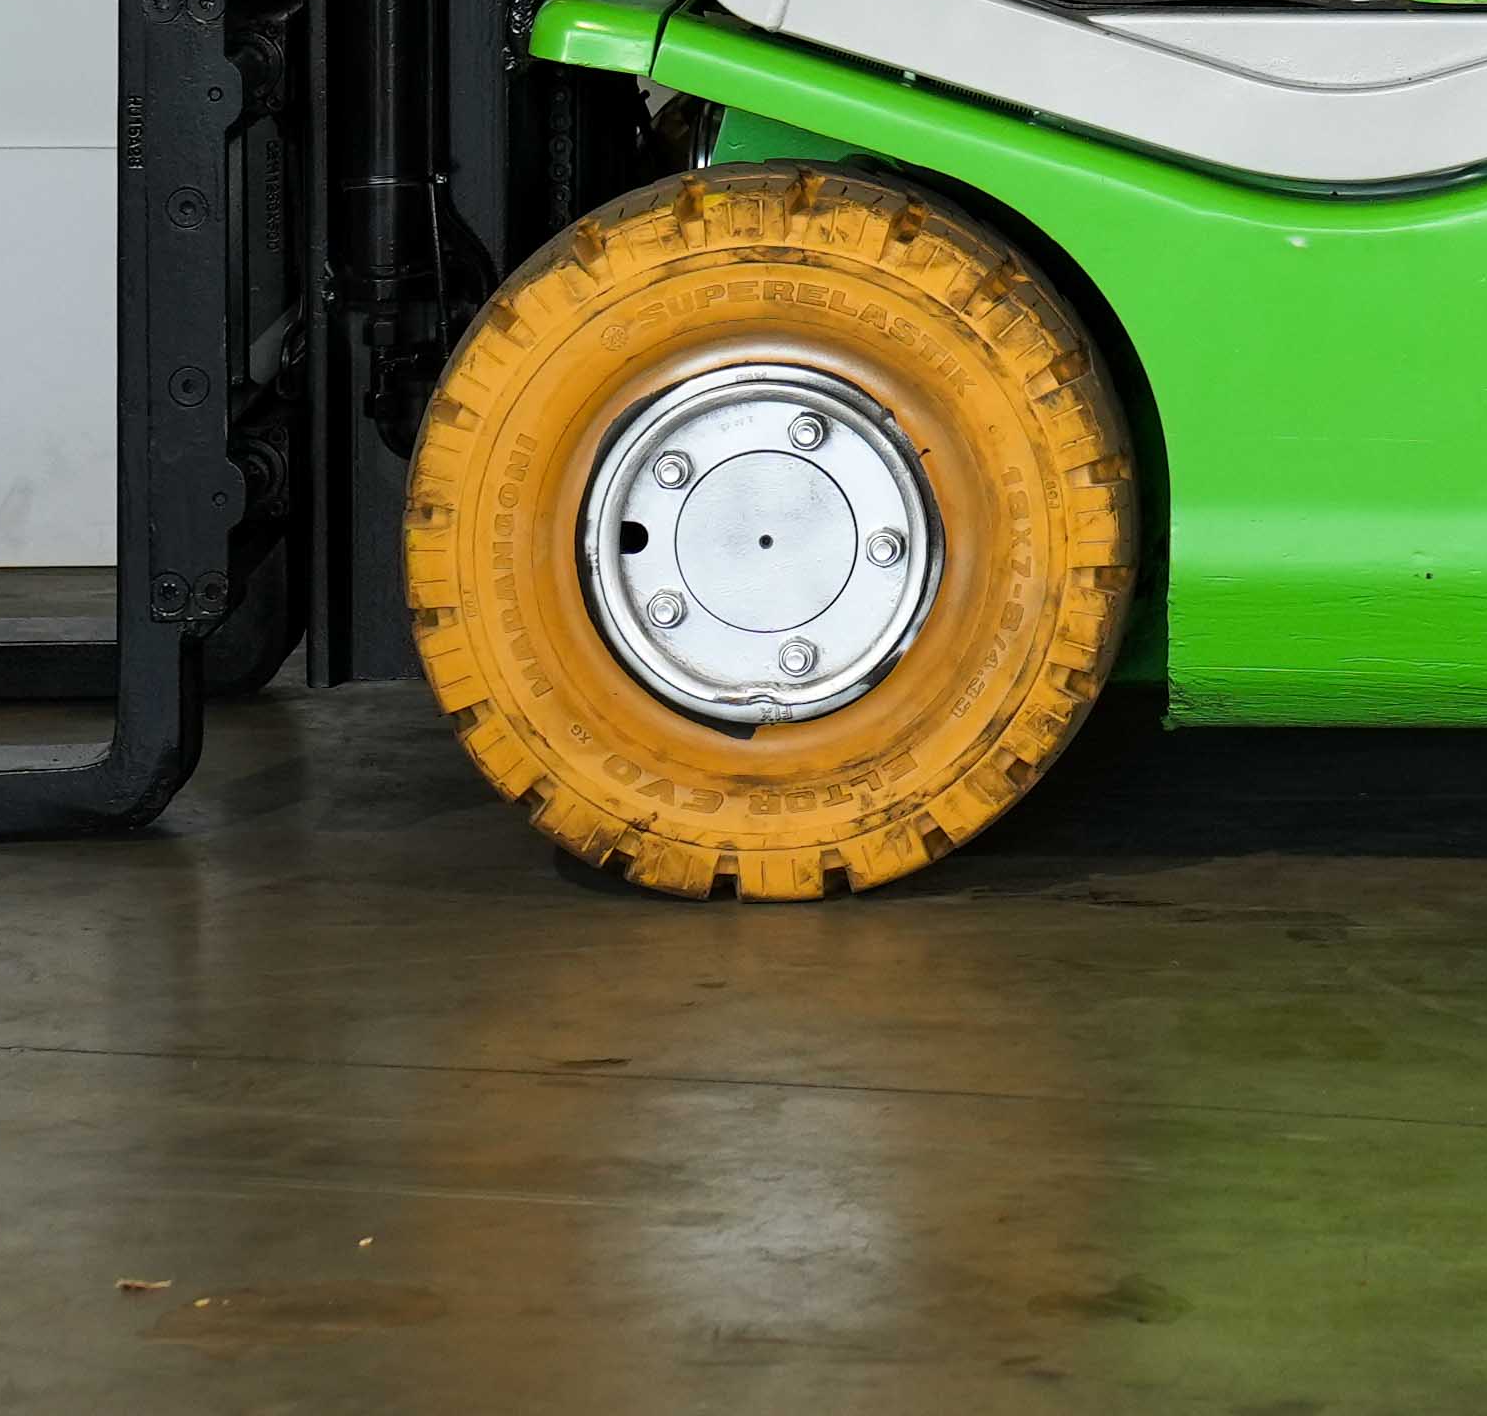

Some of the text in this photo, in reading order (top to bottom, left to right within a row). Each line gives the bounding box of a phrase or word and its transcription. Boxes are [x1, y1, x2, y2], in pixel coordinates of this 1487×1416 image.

[636, 279, 978, 398] SUPERELASTIK
[492, 432, 554, 699] MARANGONI
[602, 750, 919, 816] ELTOR EVO
